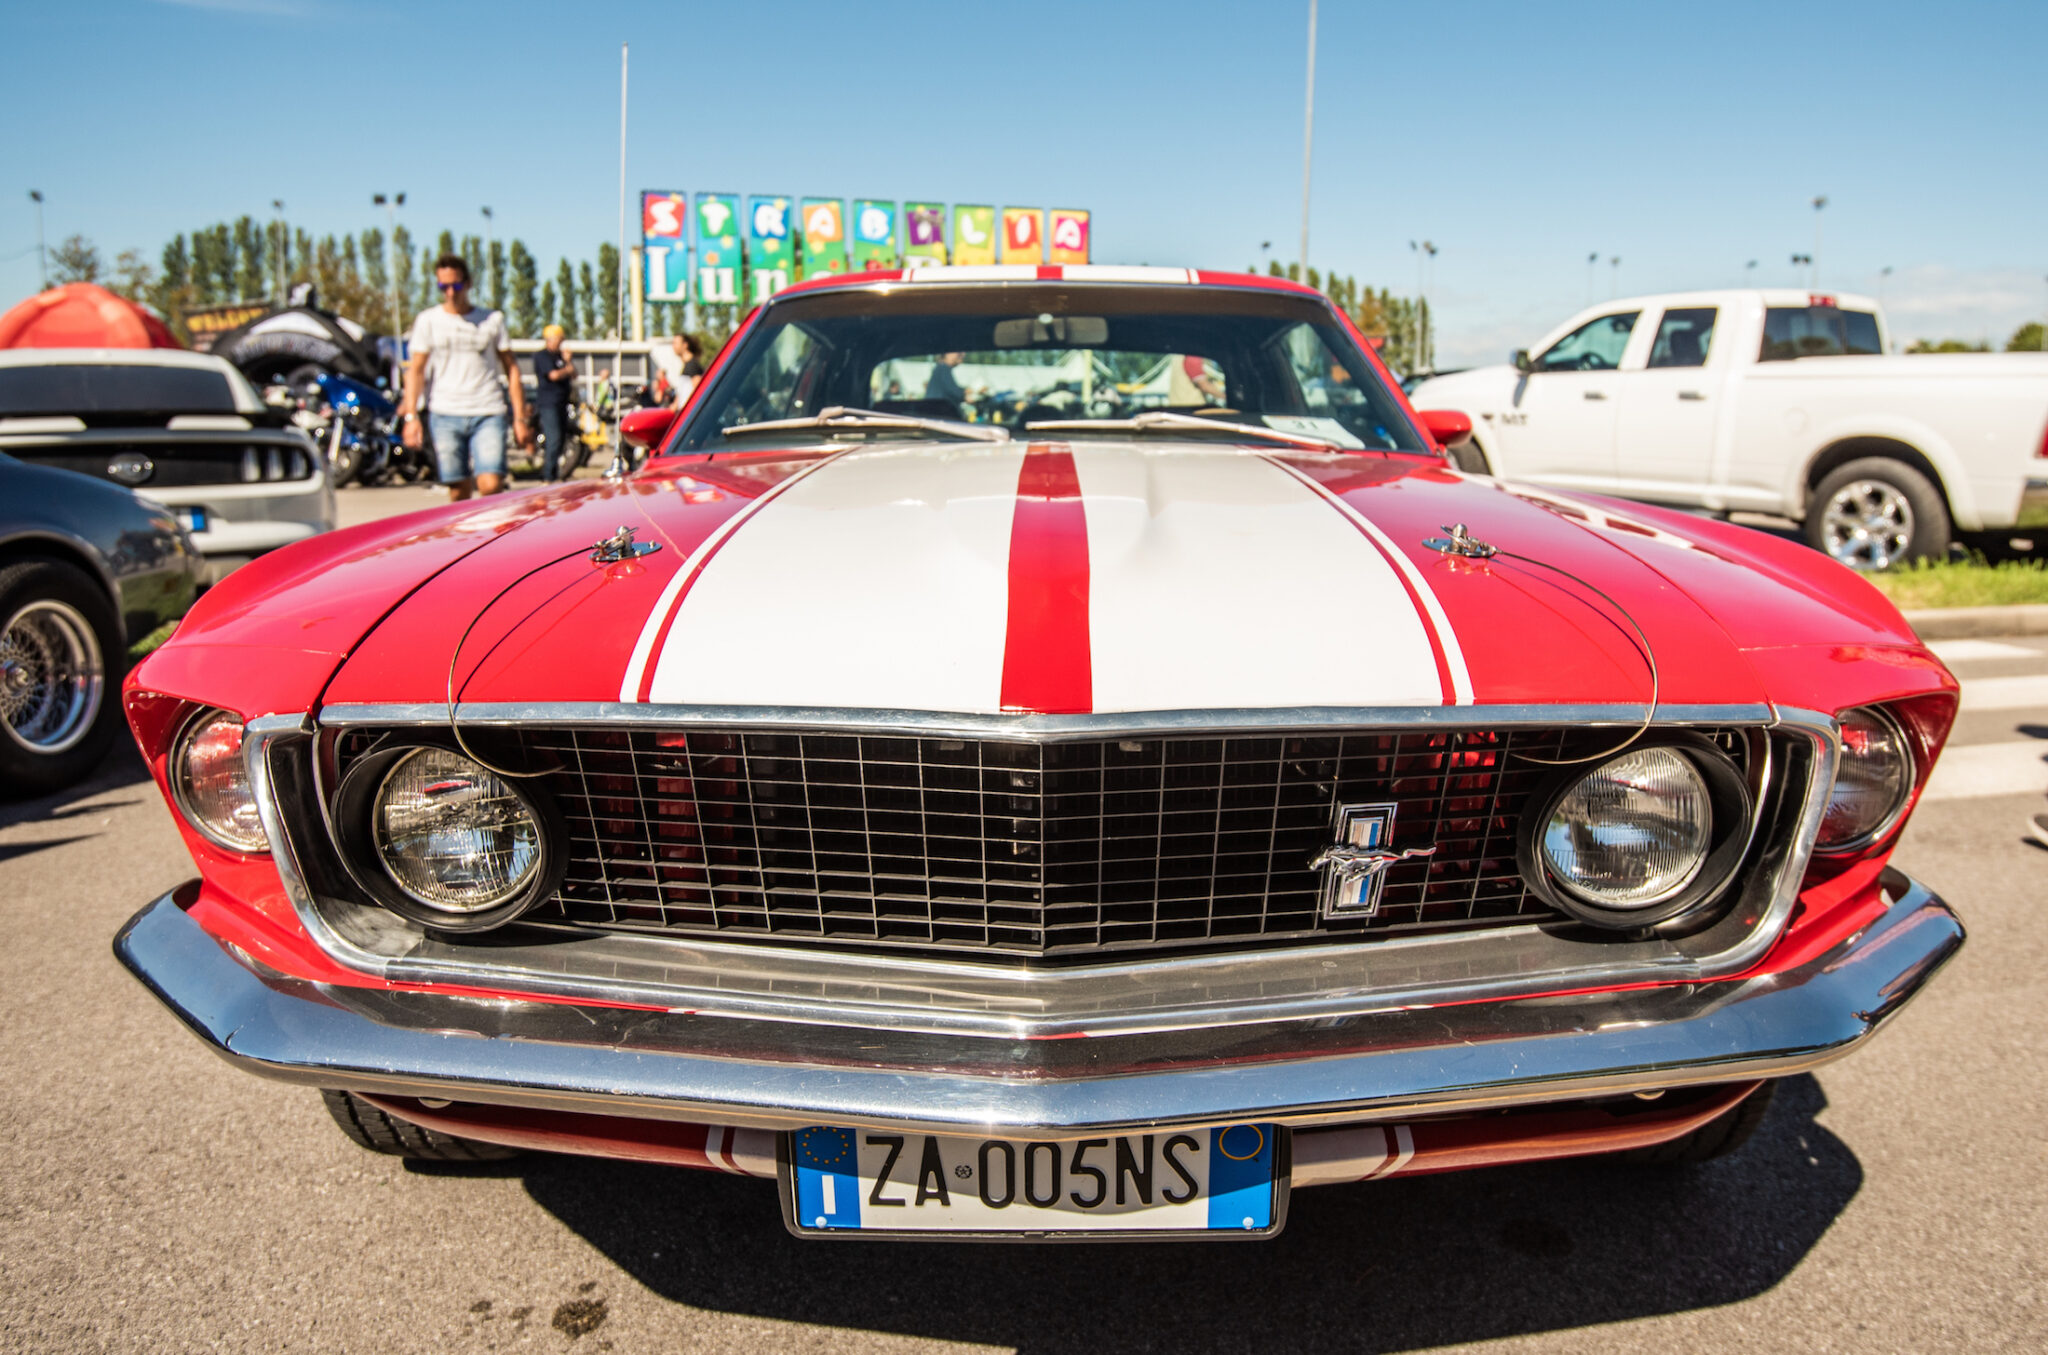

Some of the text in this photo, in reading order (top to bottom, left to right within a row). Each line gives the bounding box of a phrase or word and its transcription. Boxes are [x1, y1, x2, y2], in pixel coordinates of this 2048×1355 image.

[649, 200, 1081, 249] STRABILIA
[645, 246, 834, 303] Lun
[821, 1174, 836, 1215] I
[865, 1134, 1201, 1209] ZA 005NS
